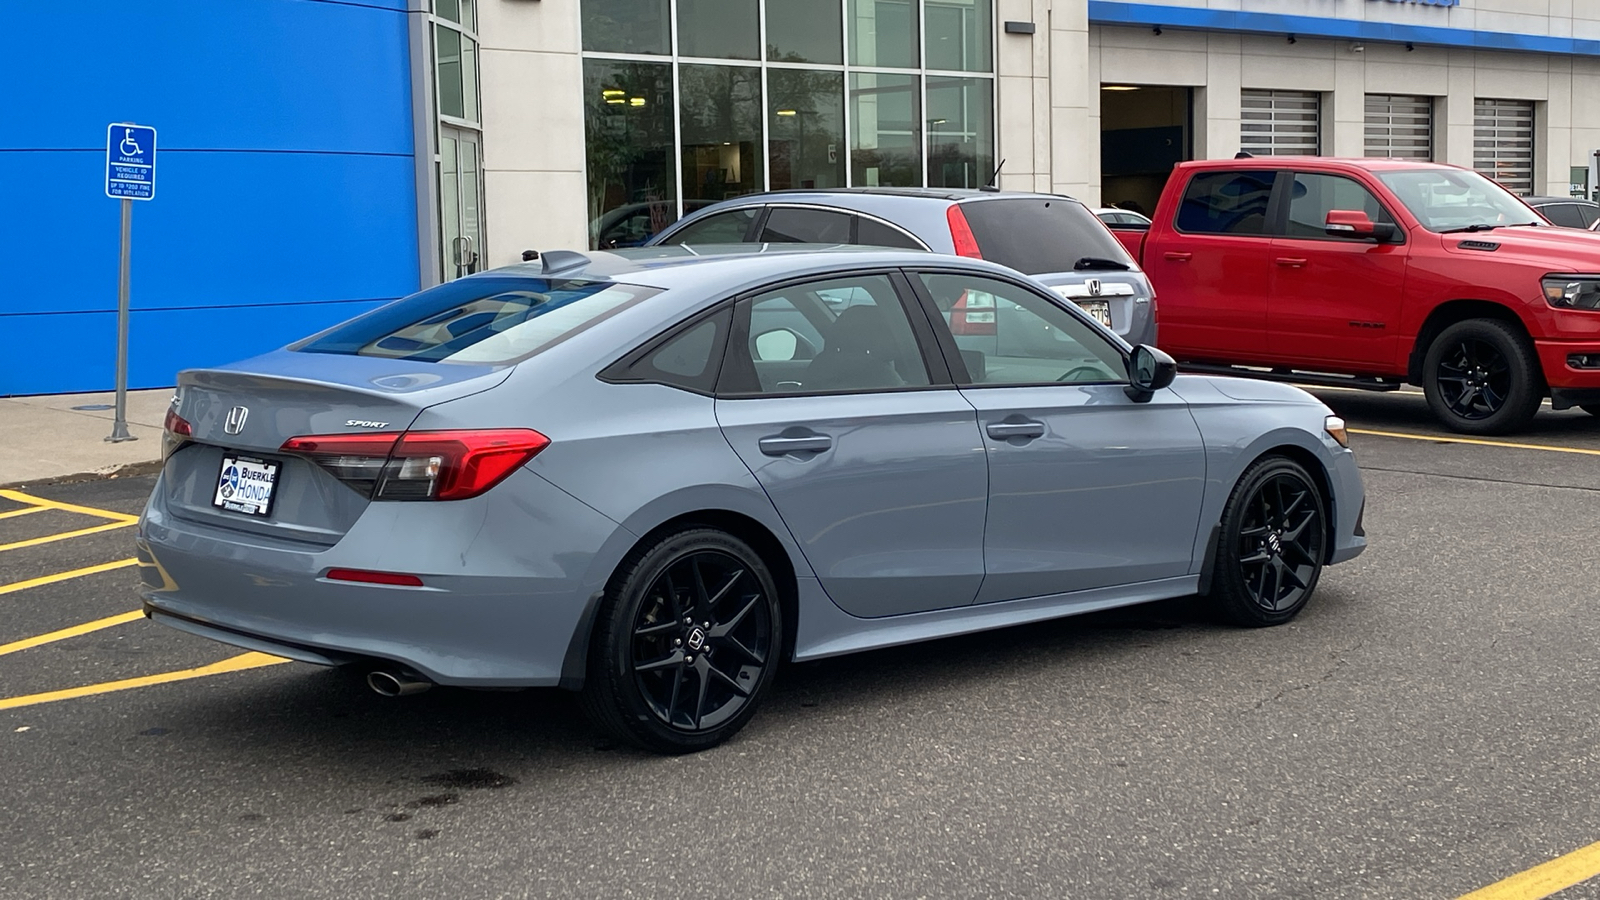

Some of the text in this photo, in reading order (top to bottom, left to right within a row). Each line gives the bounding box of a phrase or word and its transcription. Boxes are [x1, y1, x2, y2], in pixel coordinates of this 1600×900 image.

[345, 420, 390, 428] SPORT
[242, 467, 275, 482] BUERKLE
[237, 480, 270, 502] HONDA
